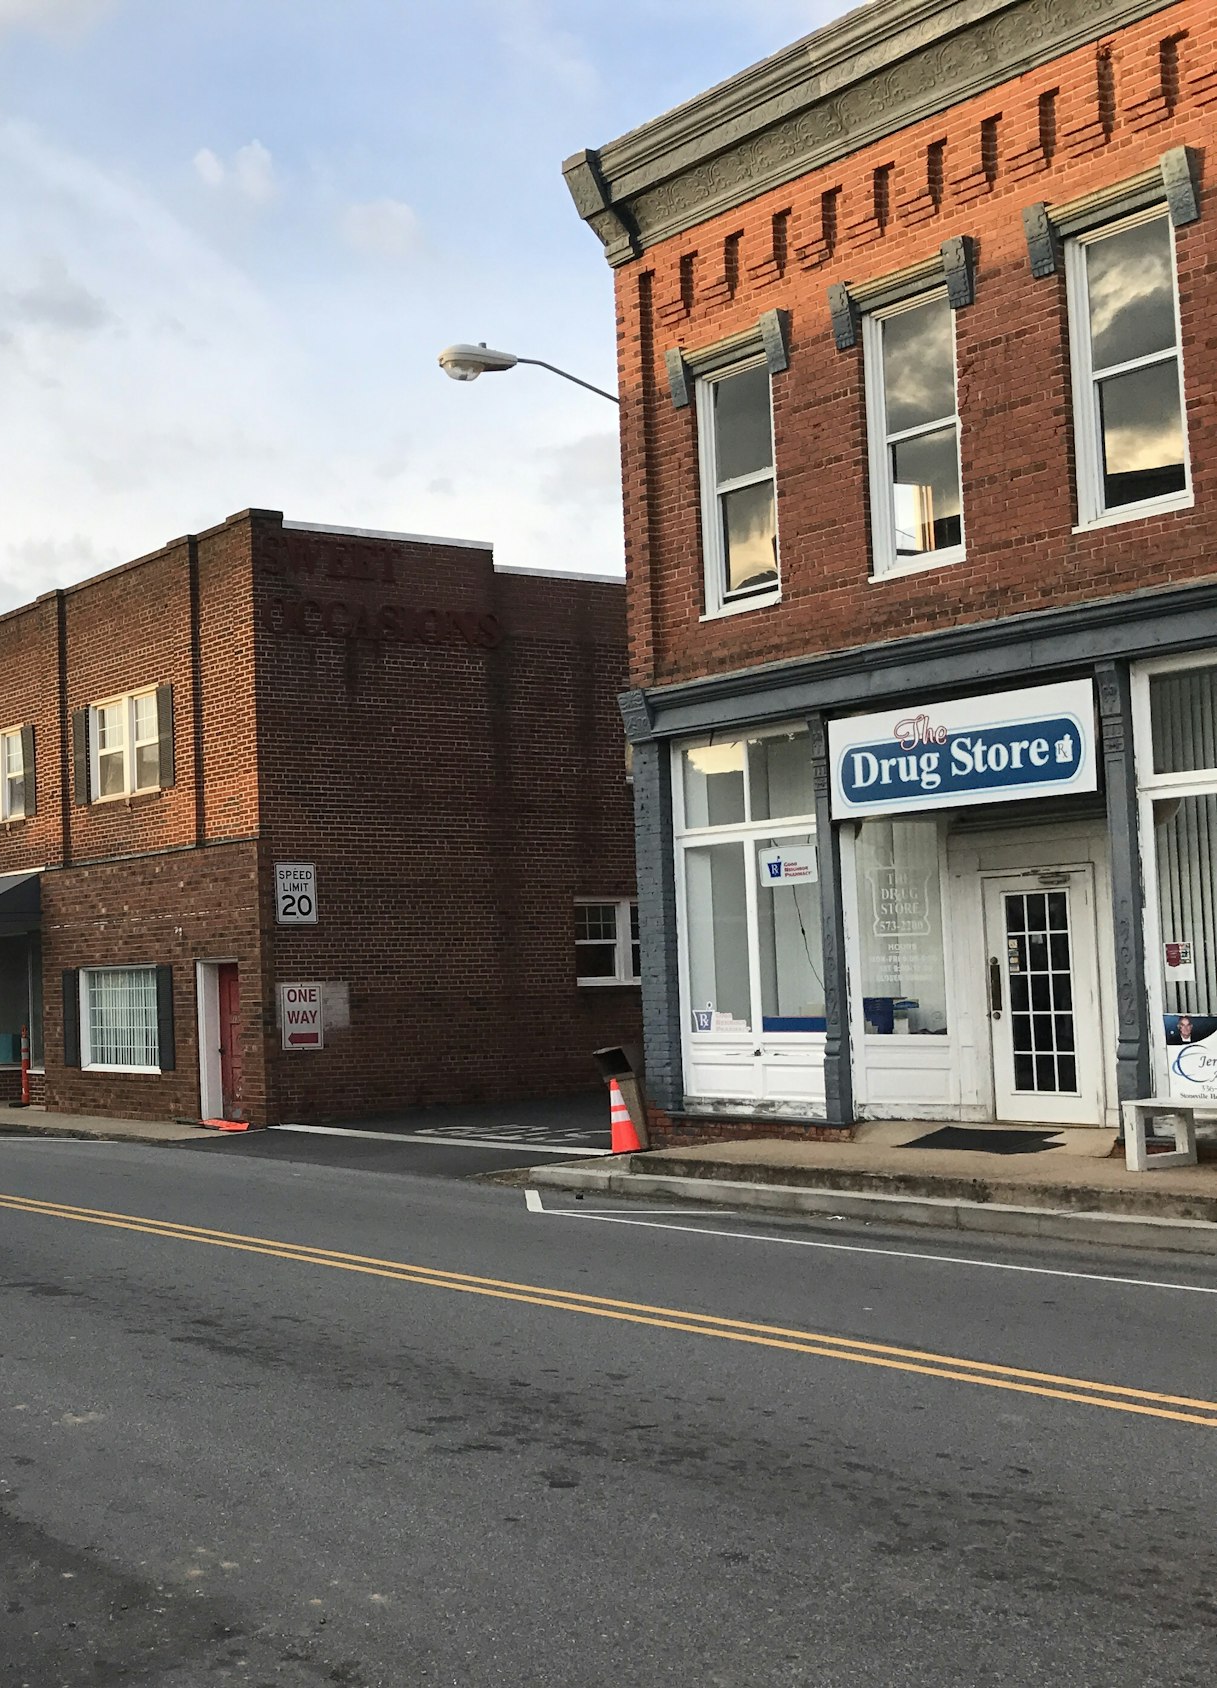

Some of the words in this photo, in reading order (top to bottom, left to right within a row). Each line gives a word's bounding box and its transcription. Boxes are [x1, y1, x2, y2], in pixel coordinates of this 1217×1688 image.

[260, 534, 400, 584] SWEET
[261, 596, 504, 649] OCCASIONS
[894, 714, 948, 751] The
[851, 752, 942, 790] Drug
[950, 737, 1050, 777] Store
[278, 870, 312, 880] SPEED
[282, 883, 309, 892] LIMIT
[880, 888, 918, 901] DRUG
[281, 894, 312, 916] 20
[881, 902, 921, 915] STORE
[286, 988, 318, 1004] ONE
[286, 1010, 319, 1025] WAY
[1180, 1092, 1209, 1100] Stoneville
